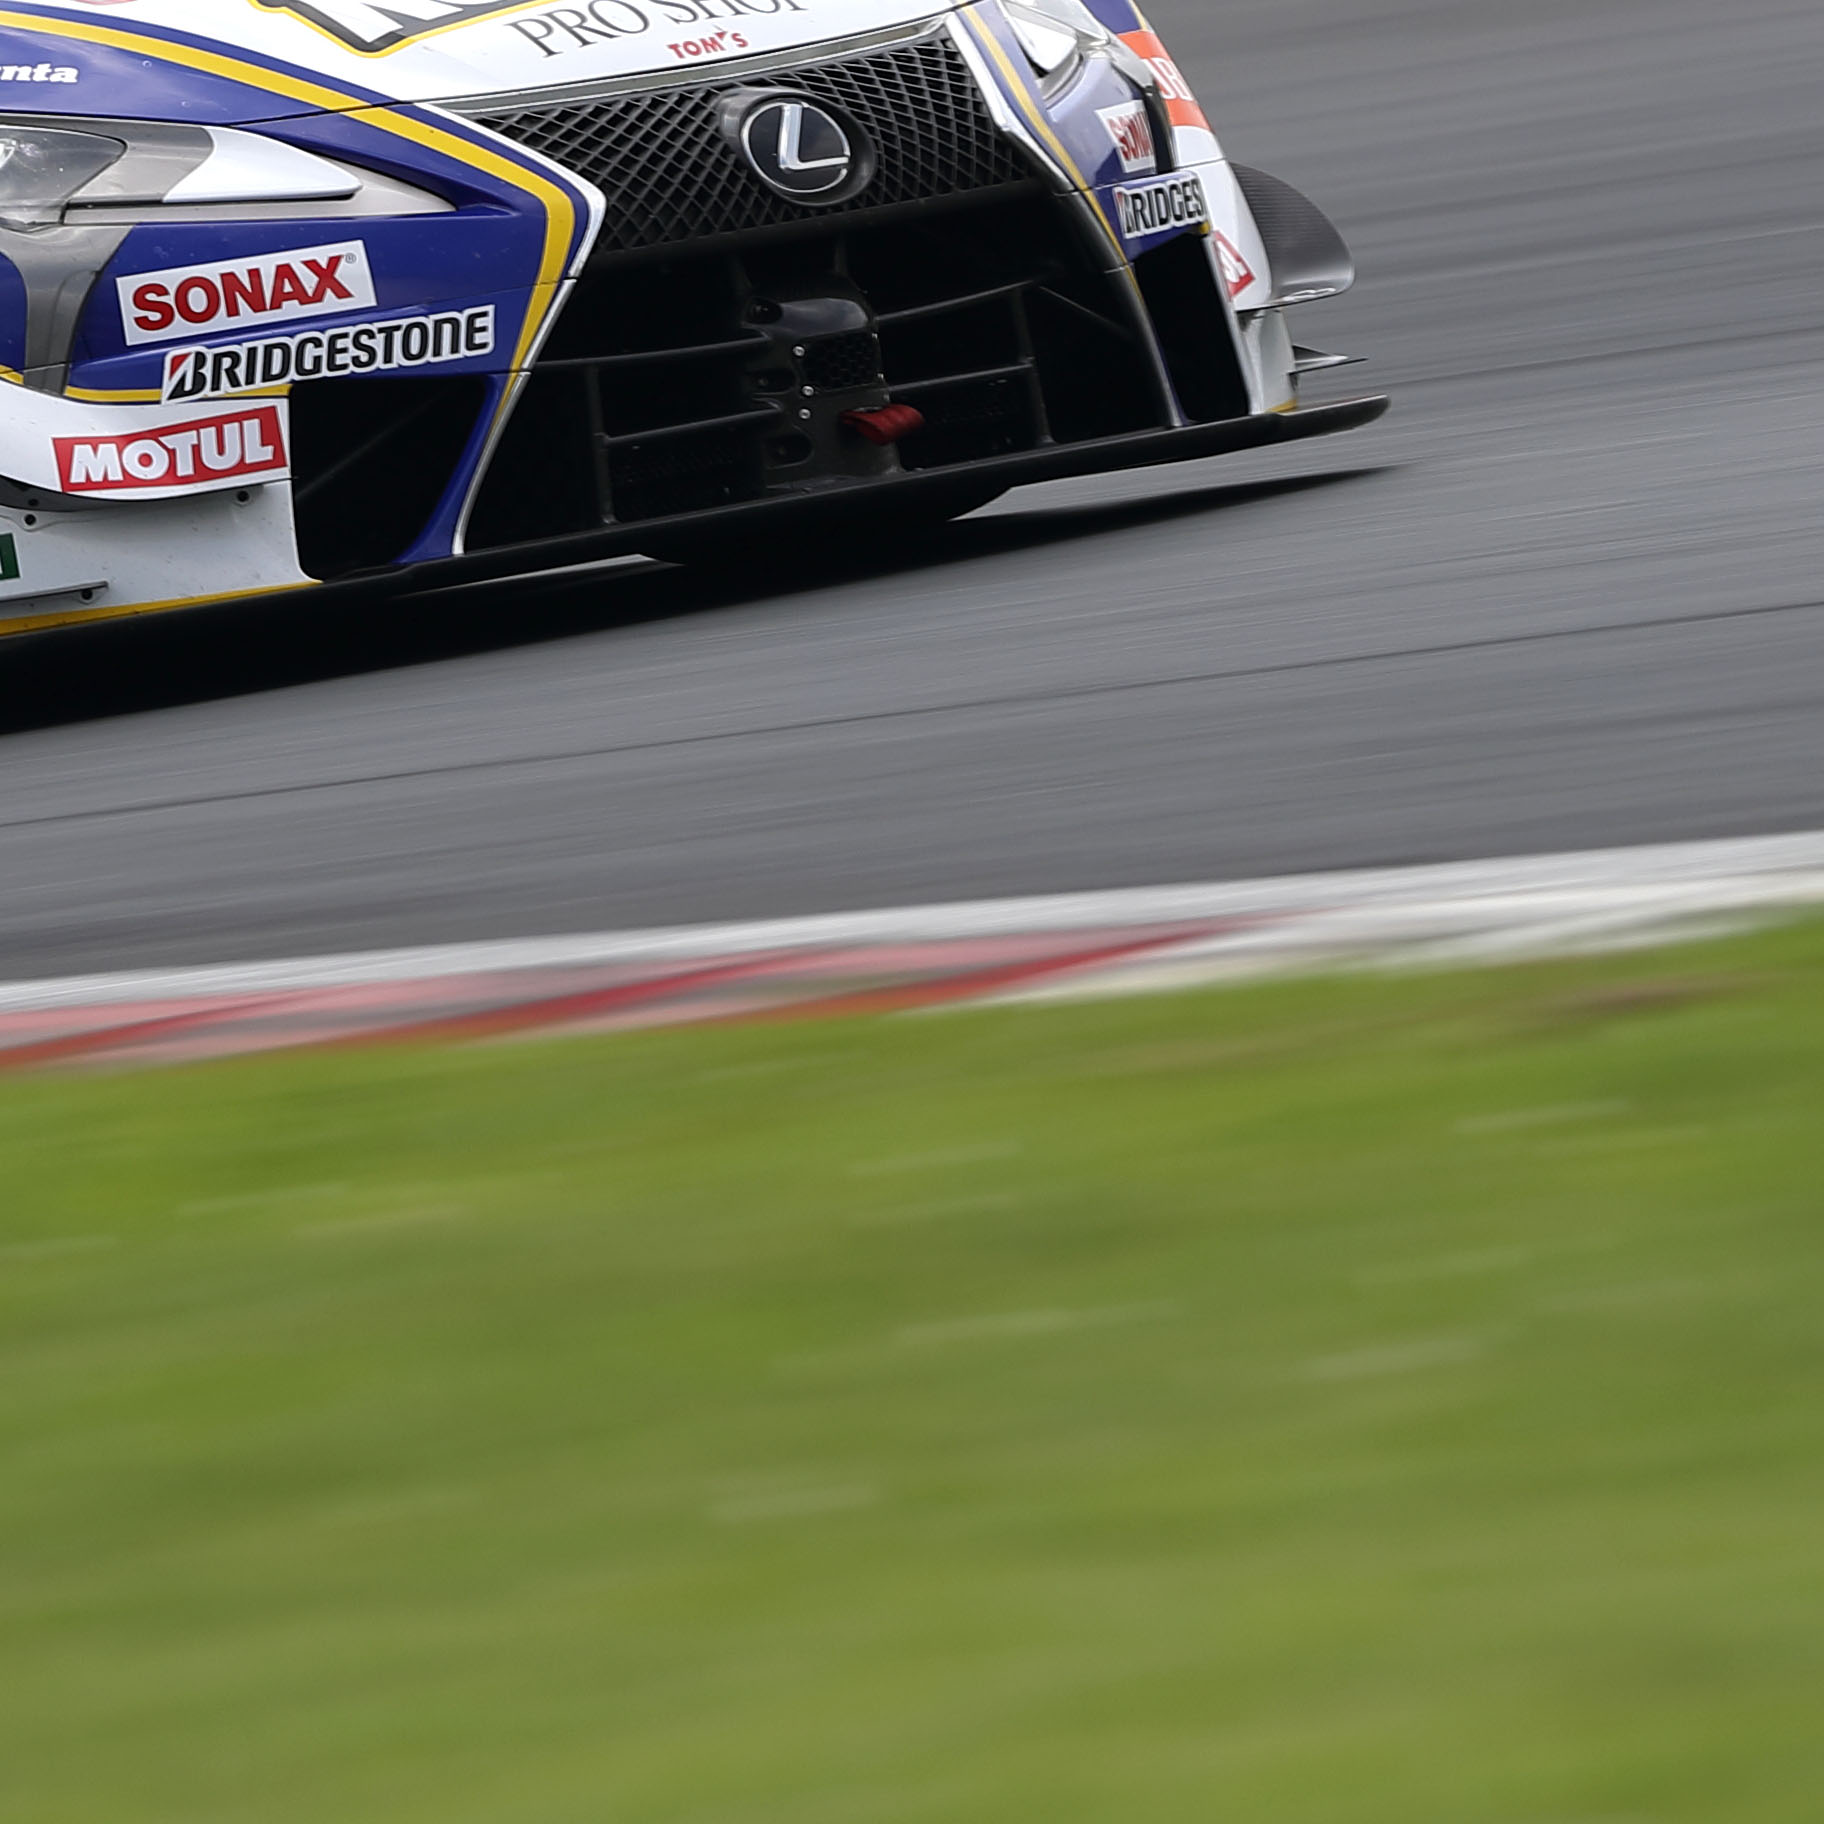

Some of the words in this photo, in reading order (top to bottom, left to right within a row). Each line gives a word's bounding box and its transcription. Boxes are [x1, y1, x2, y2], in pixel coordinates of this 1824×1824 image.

[504, 4, 652, 58] PRO
[132, 254, 356, 332] SONAX
[167, 307, 494, 402] BRIDGESTONE
[69, 420, 276, 483] MOTUL
